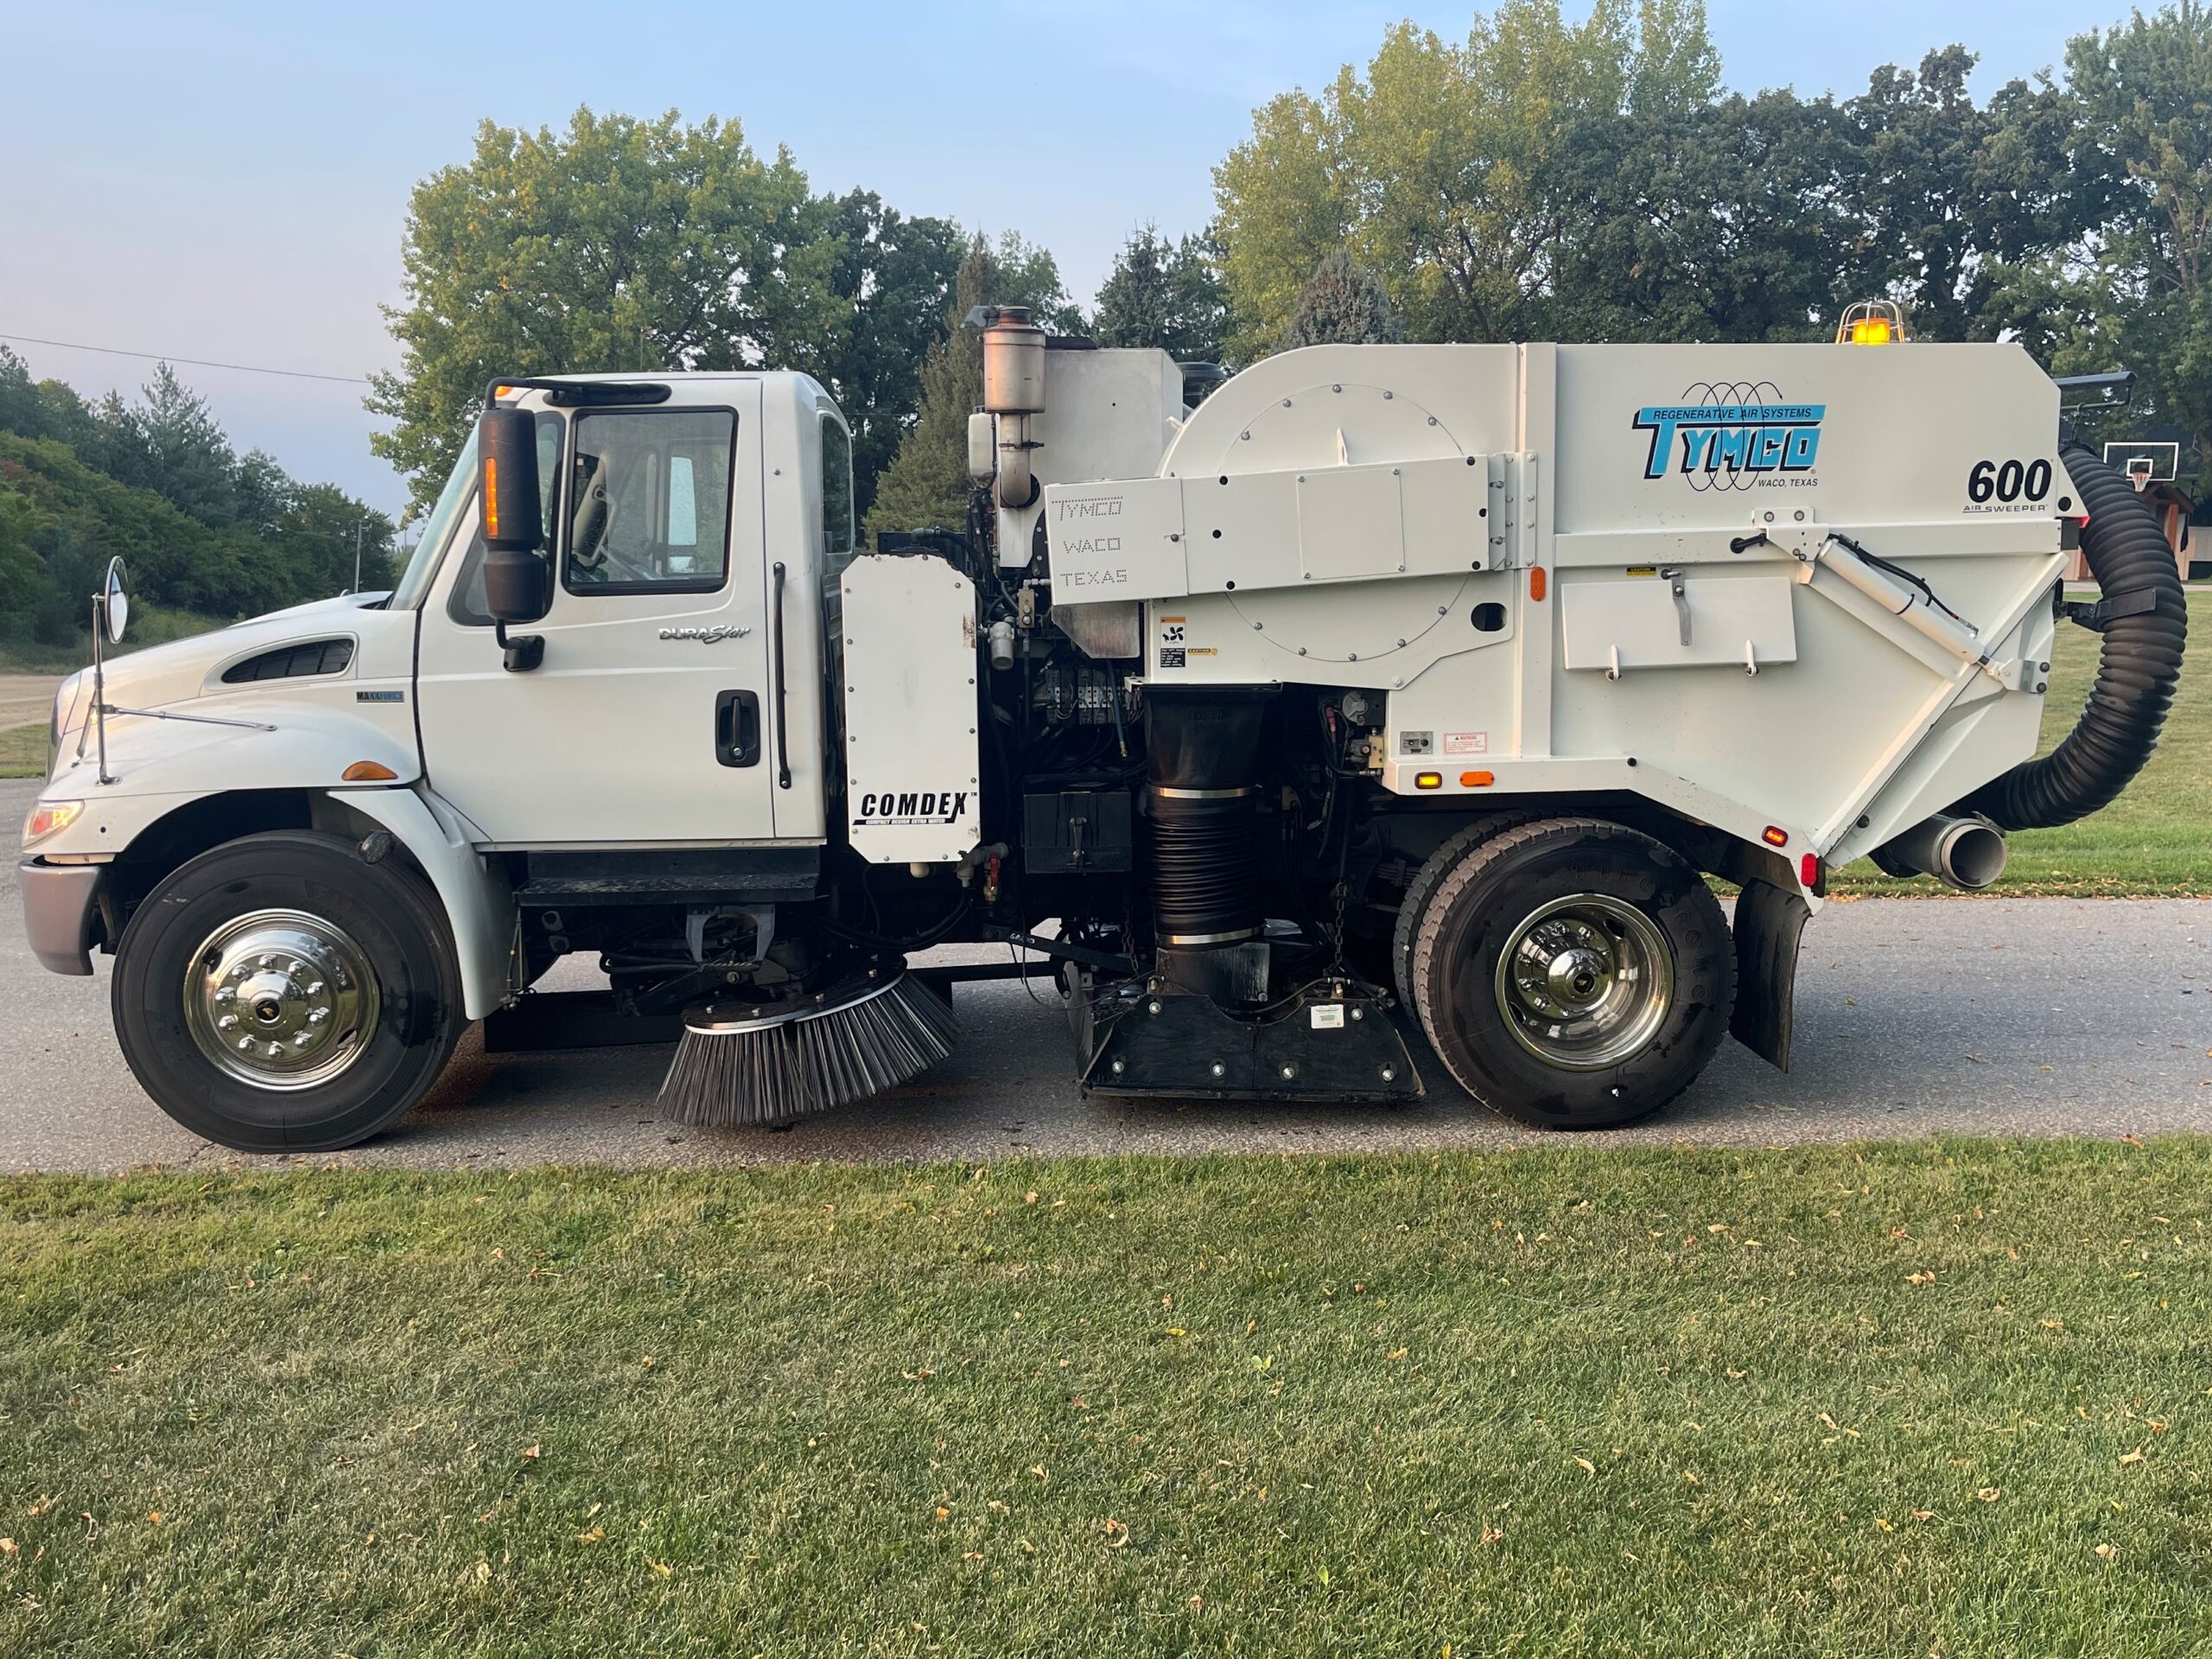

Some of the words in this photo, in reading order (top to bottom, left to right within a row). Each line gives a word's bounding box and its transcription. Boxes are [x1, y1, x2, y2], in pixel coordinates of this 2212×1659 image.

[1653, 410, 1735, 420] REGENERATIVE
[1740, 409, 1758, 419] AIR
[1763, 408, 1812, 418] SYSTEMS
[1632, 405, 1826, 480] TYMCO
[1758, 479, 1787, 487] WACO,
[1789, 478, 1818, 487] TEXAS
[1967, 459, 2052, 503] 600
[1052, 496, 1123, 521] TYMCO
[1063, 537, 1121, 554] WACO
[1060, 569, 1128, 587] TEXAS
[861, 792, 968, 817] COMDEX
